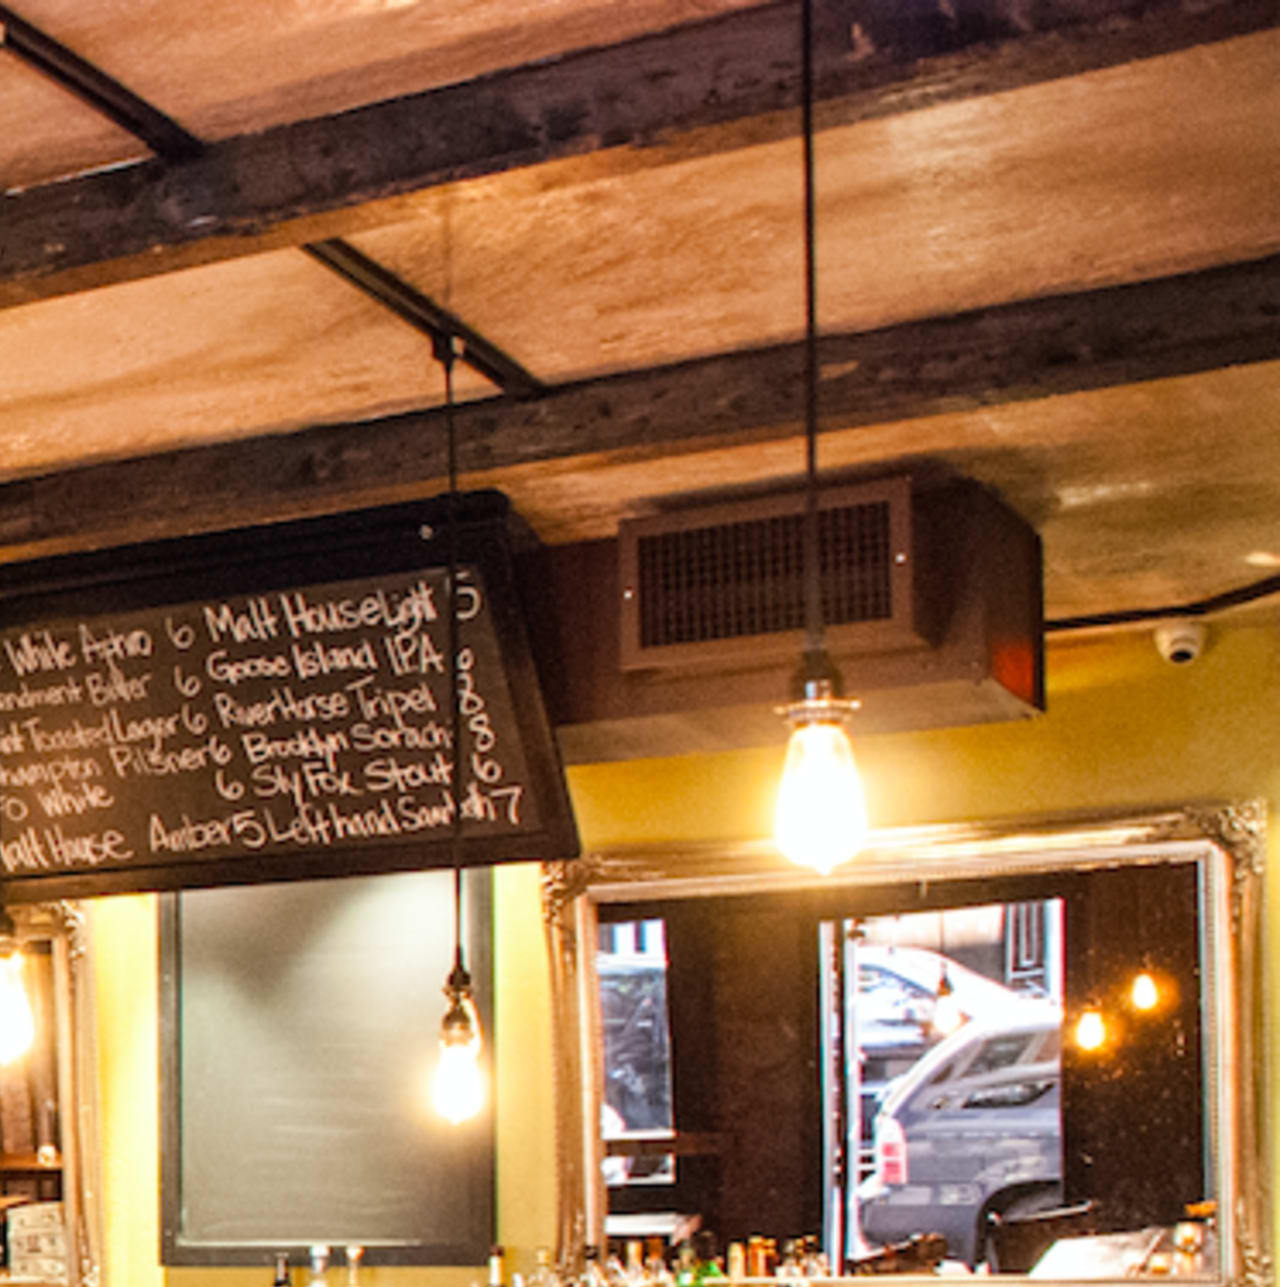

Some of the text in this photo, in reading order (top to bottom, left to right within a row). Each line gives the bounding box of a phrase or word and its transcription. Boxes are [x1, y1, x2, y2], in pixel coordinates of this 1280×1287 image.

[165, 616, 196, 650] 6
[203, 596, 278, 643] Malt
[280, 592, 380, 638] House
[206, 650, 290, 685] Goose
[290, 635, 378, 679] Island
[383, 633, 445, 676] IPA
[174, 664, 202, 698] 6
[181, 704, 208, 735] 6
[469, 712, 496, 751] 8
[208, 735, 234, 766] 6
[216, 770, 245, 800] 6
[364, 753, 455, 792] Stout
[472, 753, 502, 784] 6
[489, 785, 522, 825] 7
[149, 813, 231, 852] Amber
[232, 810, 267, 848] 5
